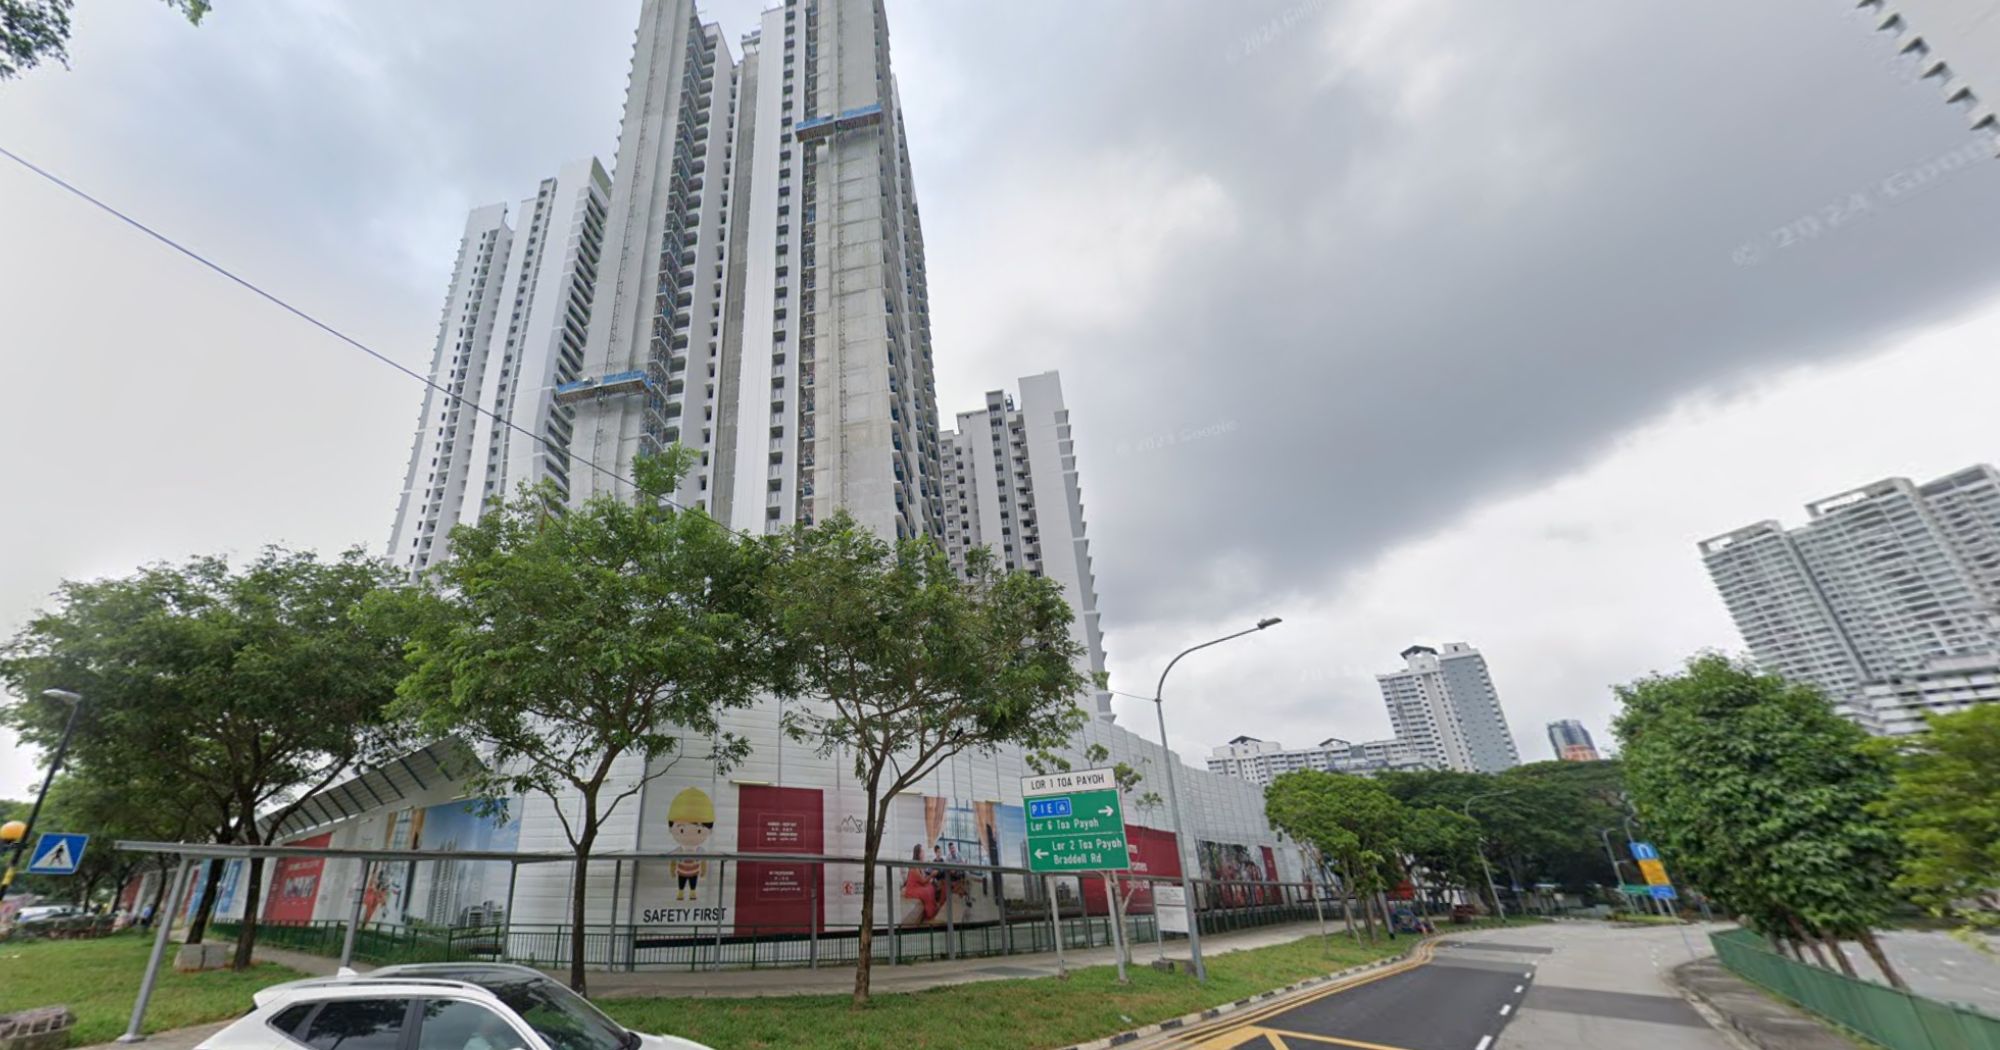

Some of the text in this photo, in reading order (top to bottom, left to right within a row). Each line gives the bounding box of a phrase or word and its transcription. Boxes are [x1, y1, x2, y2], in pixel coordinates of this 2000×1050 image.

[1031, 780, 1046, 790] LOR
[1057, 777, 1072, 788] TOA
[1076, 774, 1105, 786] PAYOH
[1031, 802, 1053, 815] PIE
[1030, 817, 1099, 832] Lor 6 Toa Payoh
[1052, 841, 1066, 851] Lor
[1069, 840, 1075, 851] 2
[1078, 839, 1093, 850] Toa
[1096, 837, 1122, 851] Payoh
[1053, 852, 1102, 865] Braddell Rd
[643, 907, 728, 924] SAFETY FIRST
